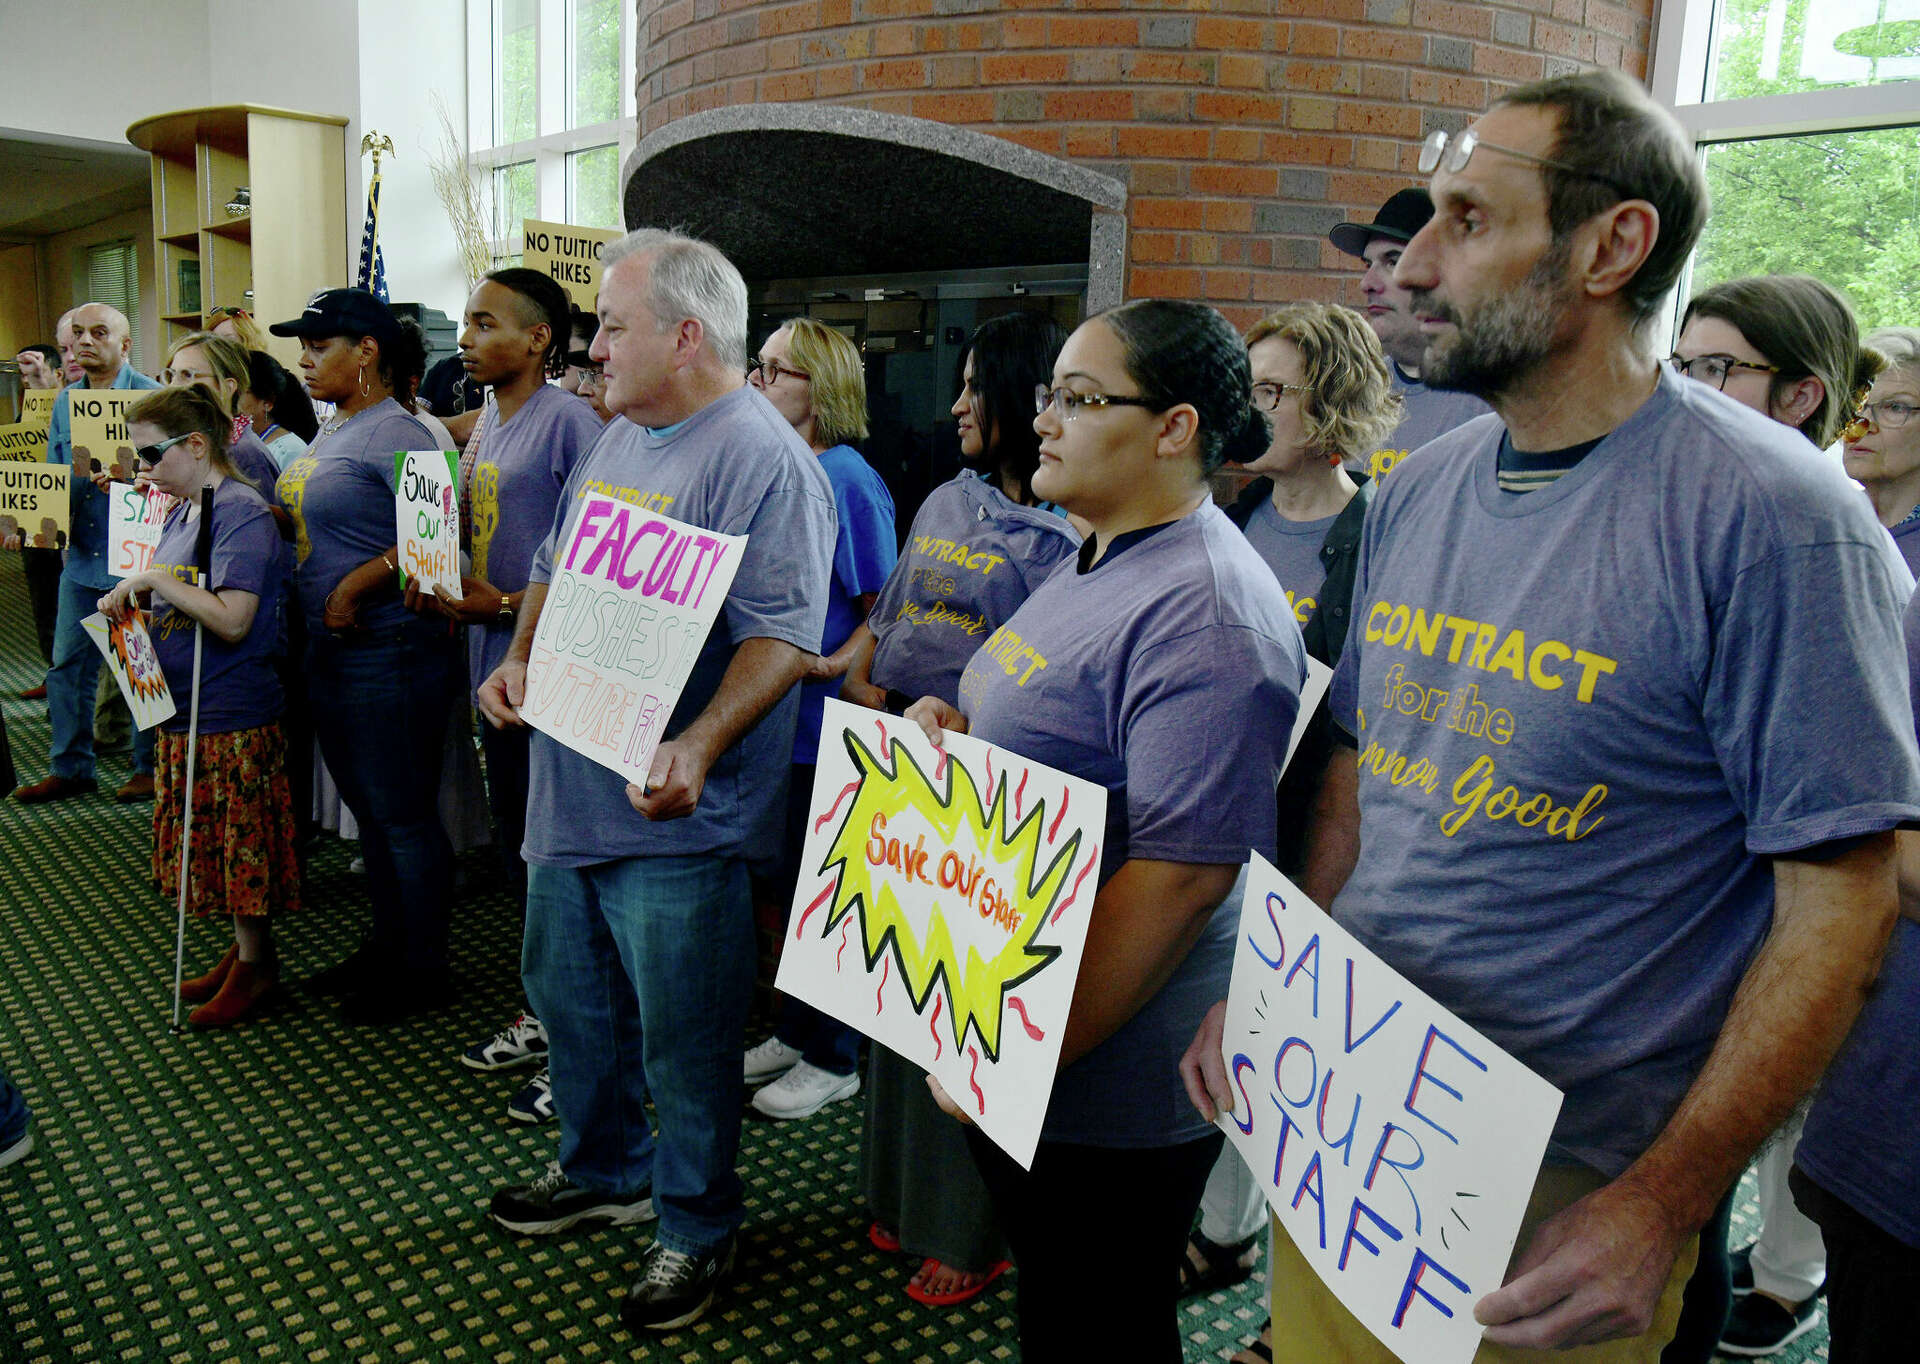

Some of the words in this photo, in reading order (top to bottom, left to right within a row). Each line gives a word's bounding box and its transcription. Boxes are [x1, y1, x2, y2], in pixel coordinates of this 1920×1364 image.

[526, 231, 549, 253] NO
[554, 235, 605, 261] TUITIO
[551, 260, 591, 284] HIKES
[0, 428, 49, 449] UITION
[73, 400, 102, 418] NO
[0, 471, 65, 491] UITION
[2, 493, 38, 511] IKES
[404, 456, 440, 508] Save
[565, 499, 728, 609] FACULTY
[541, 572, 680, 680] PUSHES
[1365, 601, 1618, 704] CONTRACT
[529, 646, 637, 752] FUTURE
[1384, 664, 1450, 721] for
[1440, 754, 1608, 841] Good
[866, 811, 933, 885] Save
[937, 850, 985, 908] Our
[979, 877, 1022, 934] Staff
[1248, 891, 1488, 1145] SAVE
[1274, 1036, 1425, 1237] OUR
[1230, 1053, 1472, 1330] STAFF
